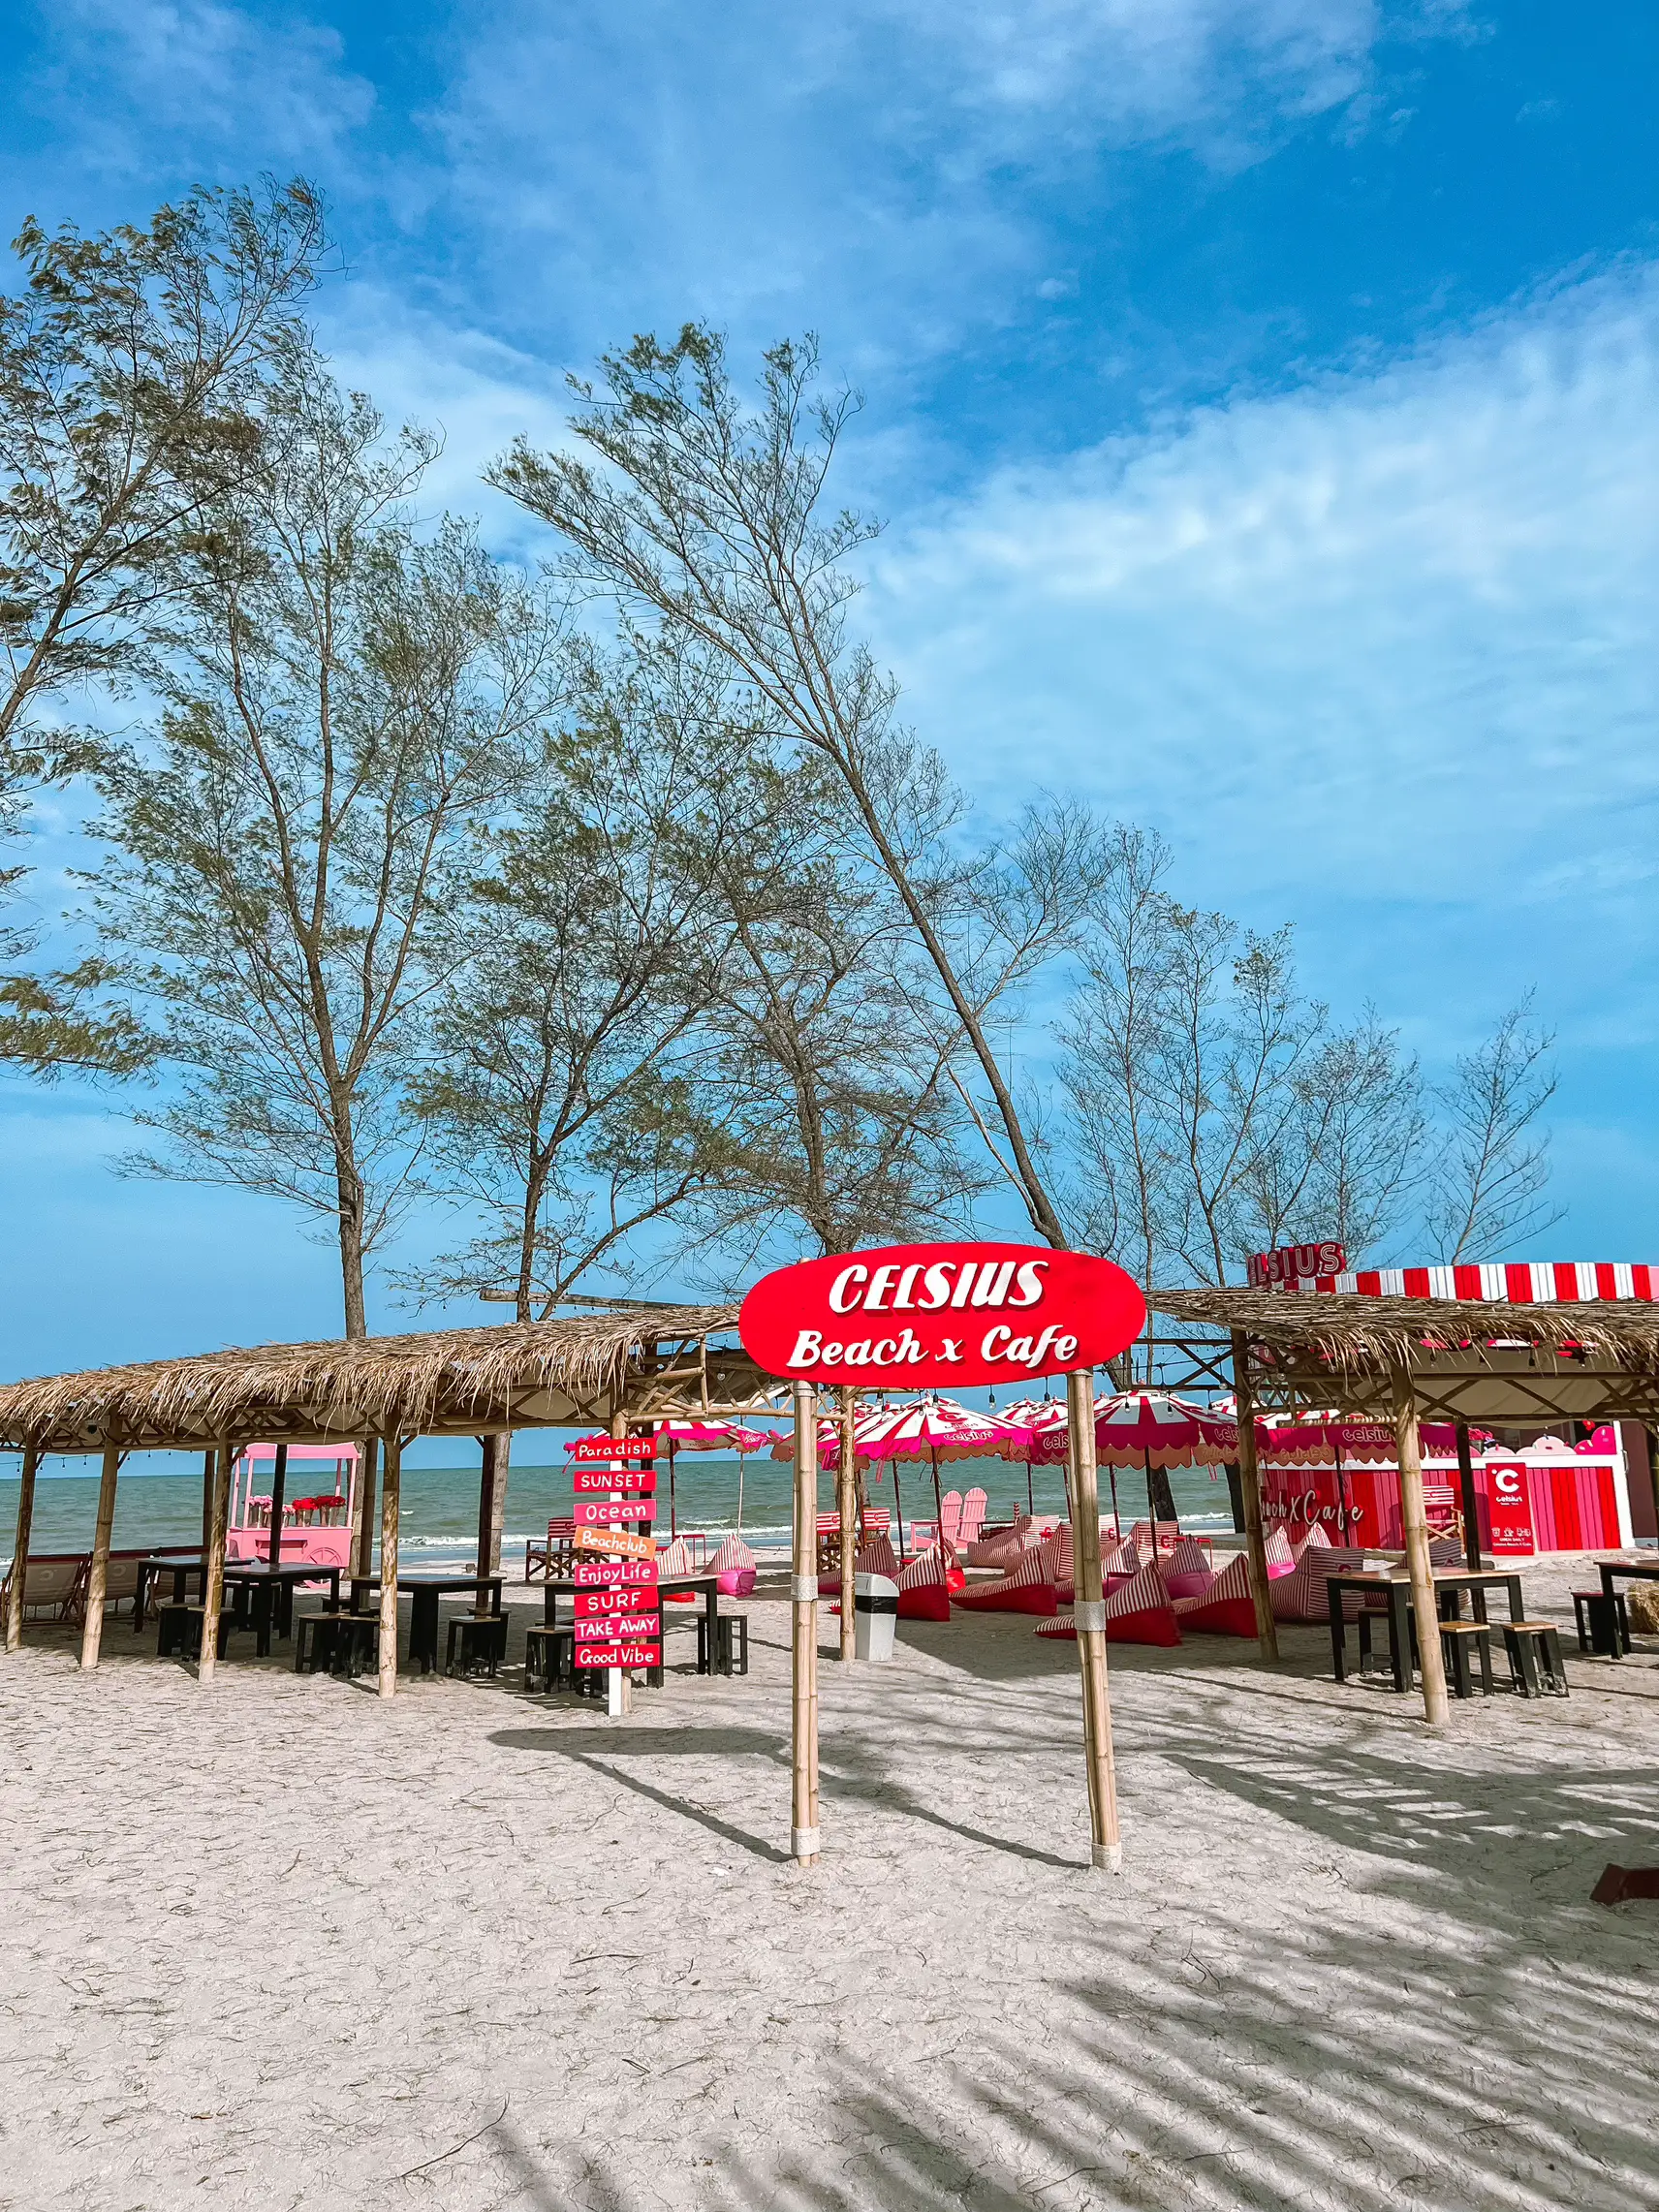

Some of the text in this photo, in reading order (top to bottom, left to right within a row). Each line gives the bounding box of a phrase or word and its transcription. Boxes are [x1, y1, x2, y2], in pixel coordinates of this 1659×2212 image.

[828, 1261, 1049, 1315] CELSIUS
[786, 1324, 1079, 1369] Beach x Cafe
[1043, 1432, 1069, 1449] cels
[1342, 1426, 1396, 1442] celsiu
[579, 1441, 651, 1458] Paradish
[580, 1474, 646, 1488] SUNSET
[585, 1505, 646, 1521] Ocean
[1303, 1489, 1364, 1531] Cafe
[581, 1530, 648, 1554] Beachclub
[587, 1592, 642, 1611] SURF
[577, 1618, 656, 1637] TAKE AWAY
[579, 1647, 654, 1665] Good Vibe
